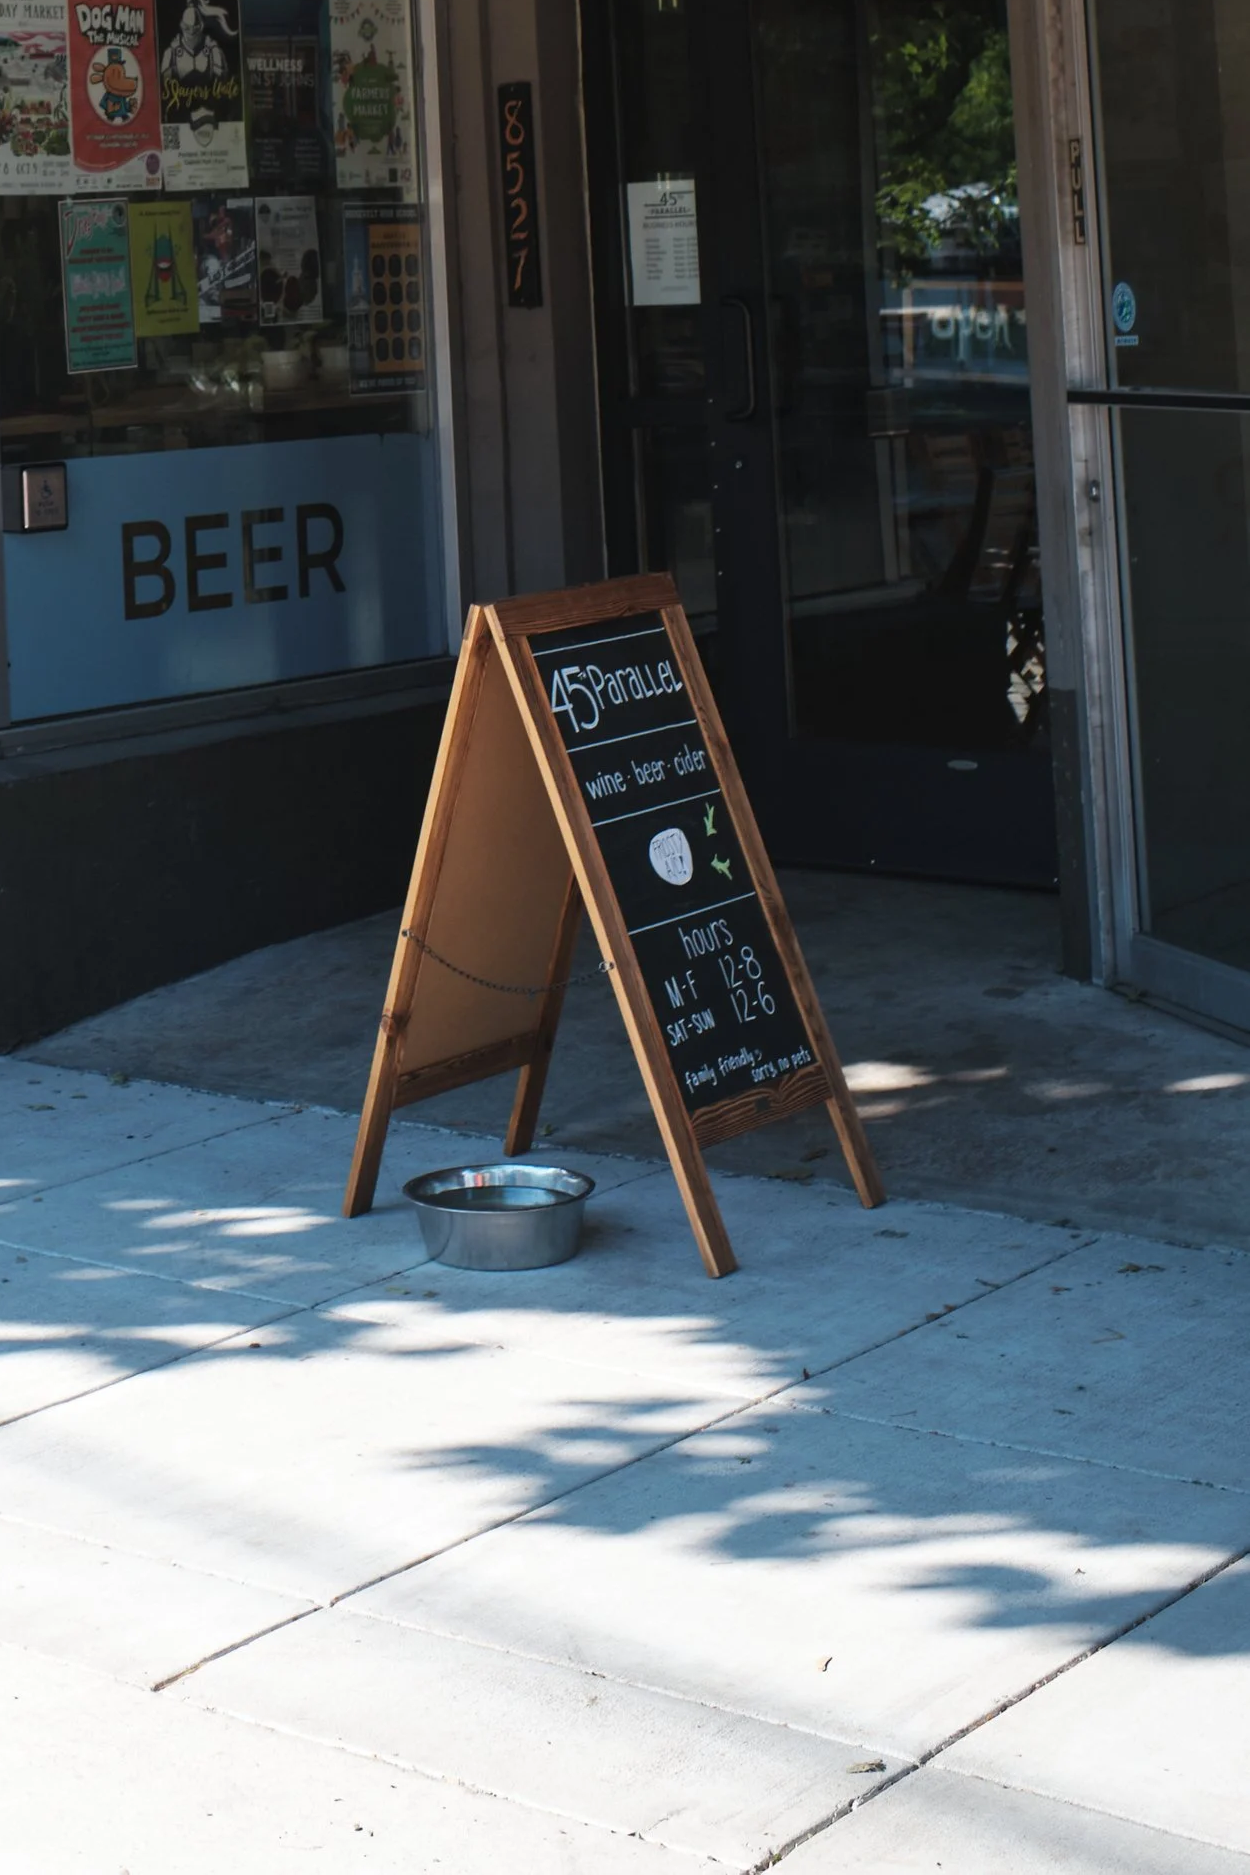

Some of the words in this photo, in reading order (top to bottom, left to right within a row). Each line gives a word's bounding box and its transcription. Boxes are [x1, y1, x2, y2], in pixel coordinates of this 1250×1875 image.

[23, 4, 66, 20] MARKET
[75, 3, 112, 33] DOG
[115, 4, 145, 34] MAN
[246, 57, 304, 72] WELLNESS
[350, 87, 390, 100] FARMERS
[353, 102, 389, 116] MARKET
[503, 99, 529, 292] 8527
[1070, 139, 1085, 245] PULL
[122, 502, 346, 620] BEER
[586, 771, 627, 800] wine
[631, 760, 665, 785] beer
[674, 744, 706, 775] cider
[678, 919, 733, 960] hours
[665, 970, 698, 1009] M-F
[718, 946, 762, 989] 12-8
[667, 1008, 716, 1046] SAT-SUN
[730, 981, 775, 1024] 12-6
[685, 1063, 718, 1094] family
[718, 1046, 756, 1076] friendly
[778, 1056, 790, 1072] no
[791, 1045, 812, 1071] pets
